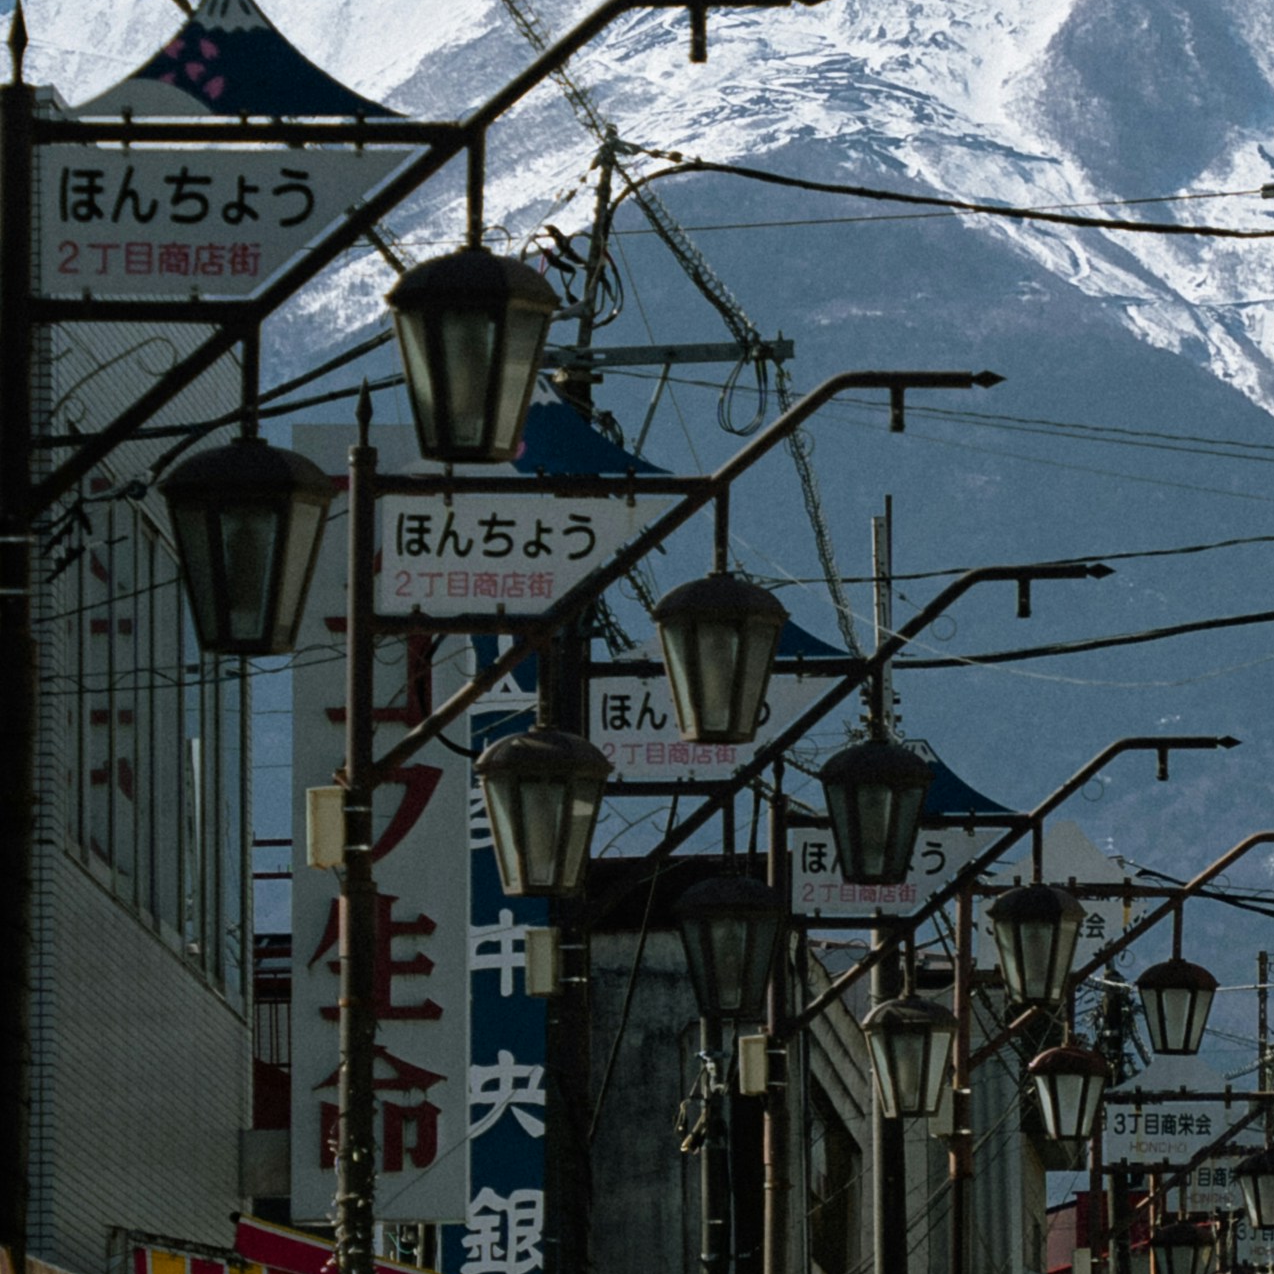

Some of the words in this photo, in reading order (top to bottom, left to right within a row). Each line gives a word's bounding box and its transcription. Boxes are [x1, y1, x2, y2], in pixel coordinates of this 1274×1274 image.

[60, 166, 314, 227] ほんちょう
[57, 240, 262, 276] 2丁目商店街
[396, 512, 596, 561] ほんちょう
[395, 570, 555, 599] 2丁目商店街
[1114, 1112, 1211, 1135] 3丁目商栄会
